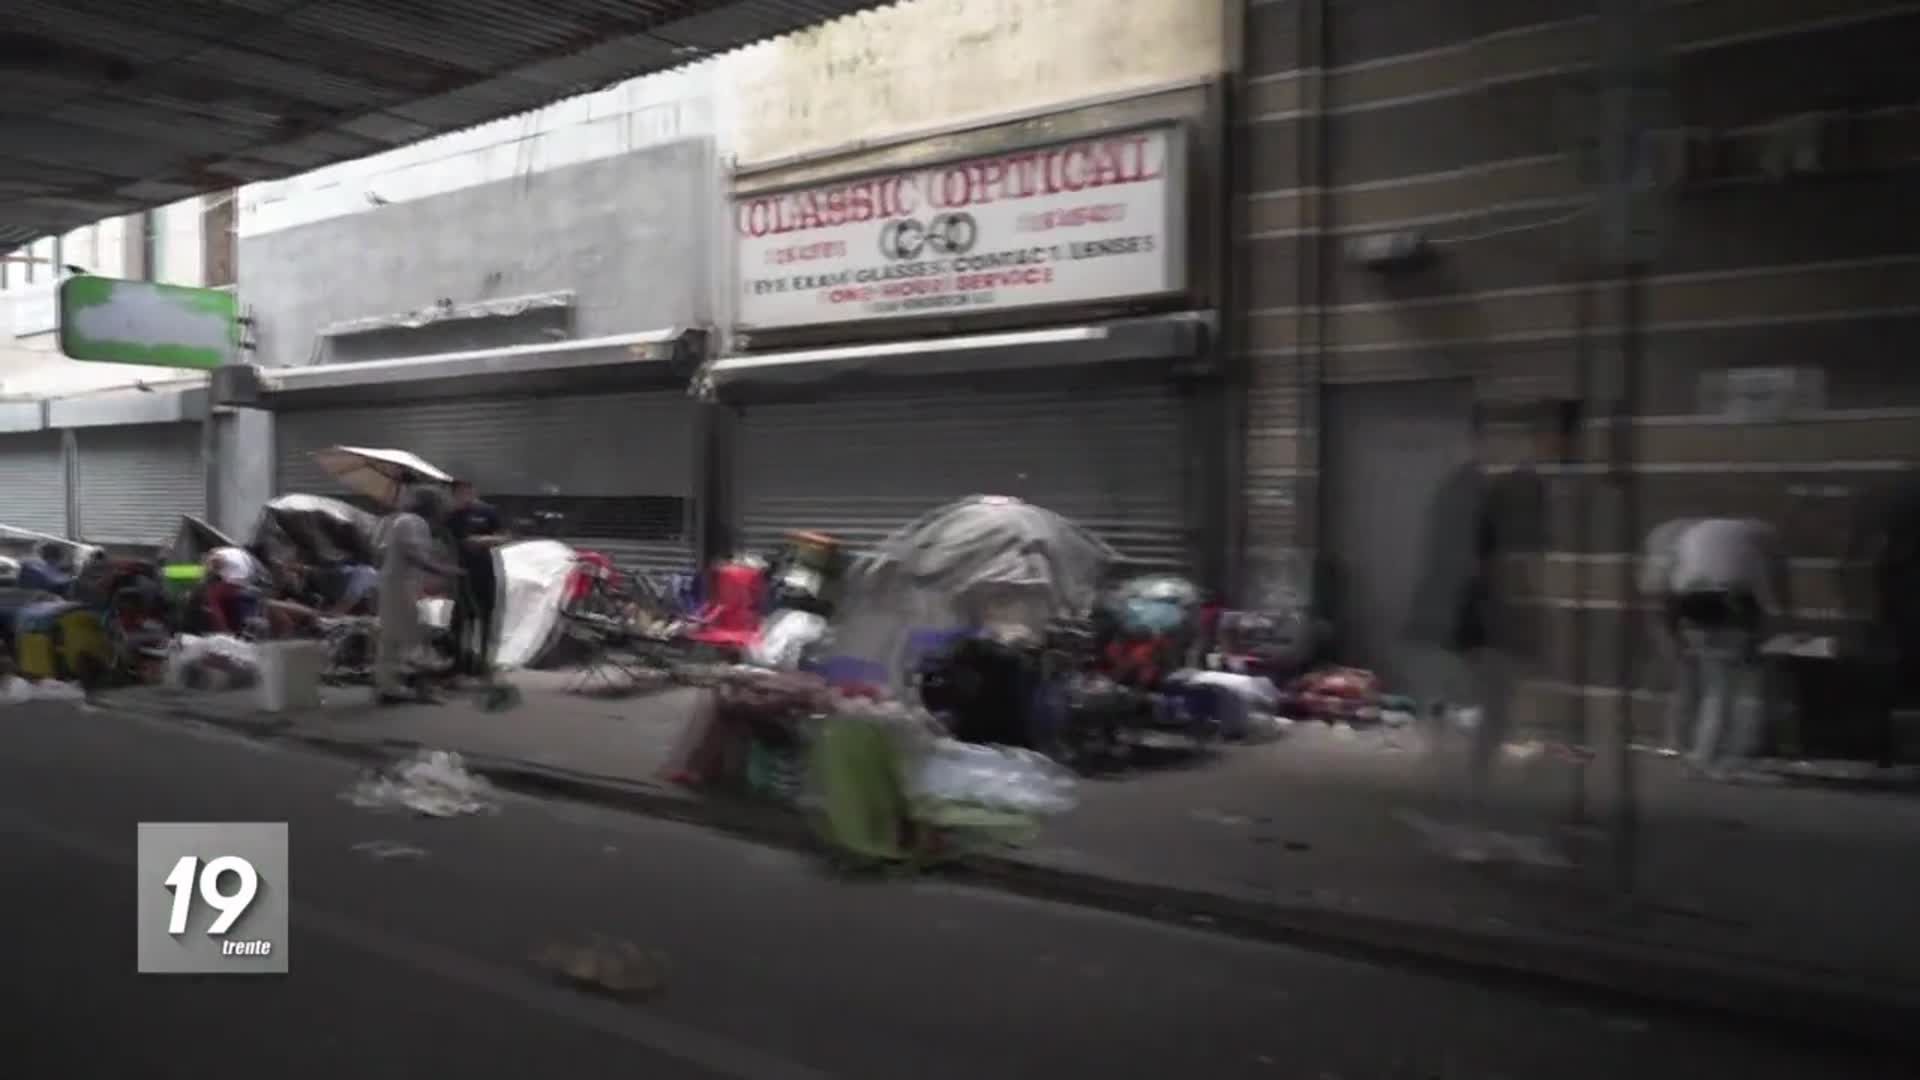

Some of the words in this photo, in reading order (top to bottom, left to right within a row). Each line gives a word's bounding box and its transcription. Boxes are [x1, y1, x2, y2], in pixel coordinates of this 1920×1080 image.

[738, 175, 914, 236] CLASSIC
[928, 137, 1162, 208] OPTICAL
[951, 245, 1061, 272] CONTACT
[1066, 235, 1156, 261] LENSES
